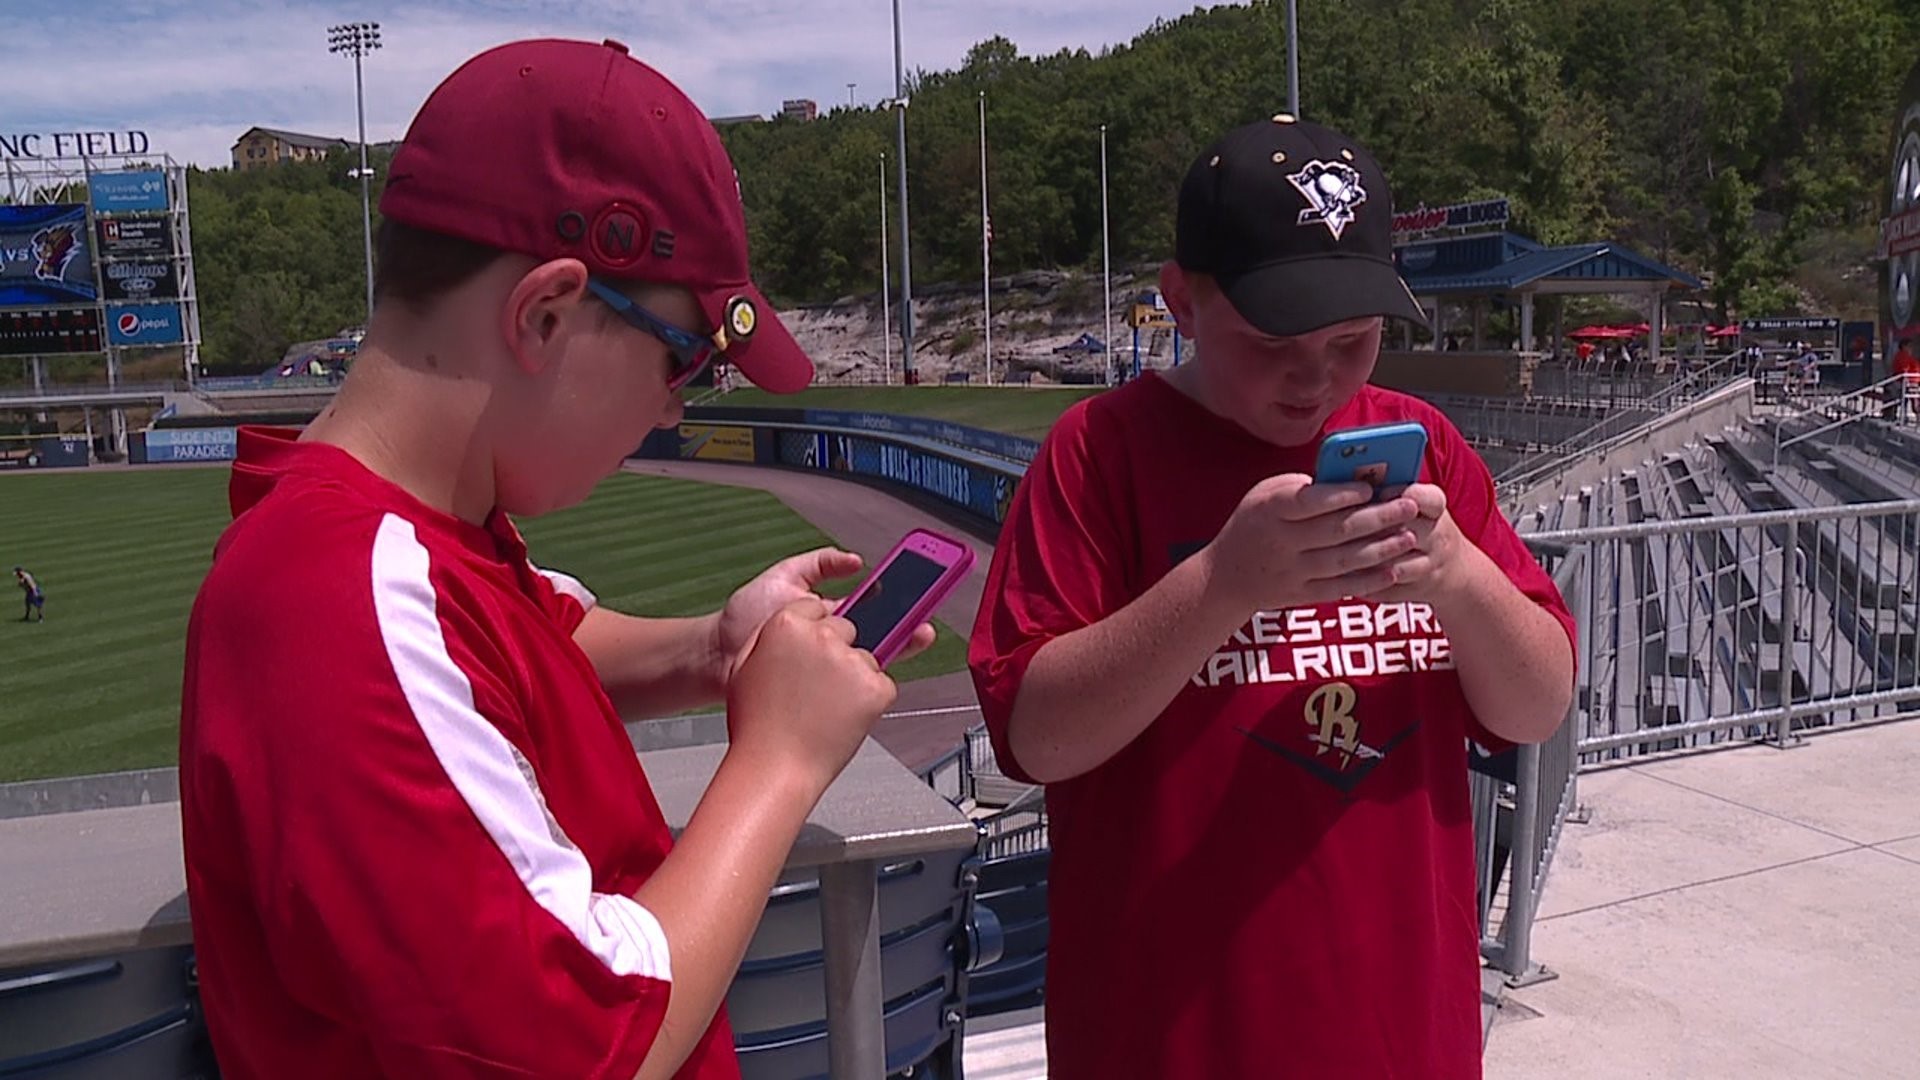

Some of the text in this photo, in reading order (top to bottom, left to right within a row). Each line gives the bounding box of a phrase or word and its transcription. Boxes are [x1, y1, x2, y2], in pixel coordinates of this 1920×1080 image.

[52, 131, 149, 157] FIELD
[556, 210, 676, 259] ONE
[140, 317, 170, 330] pepsi
